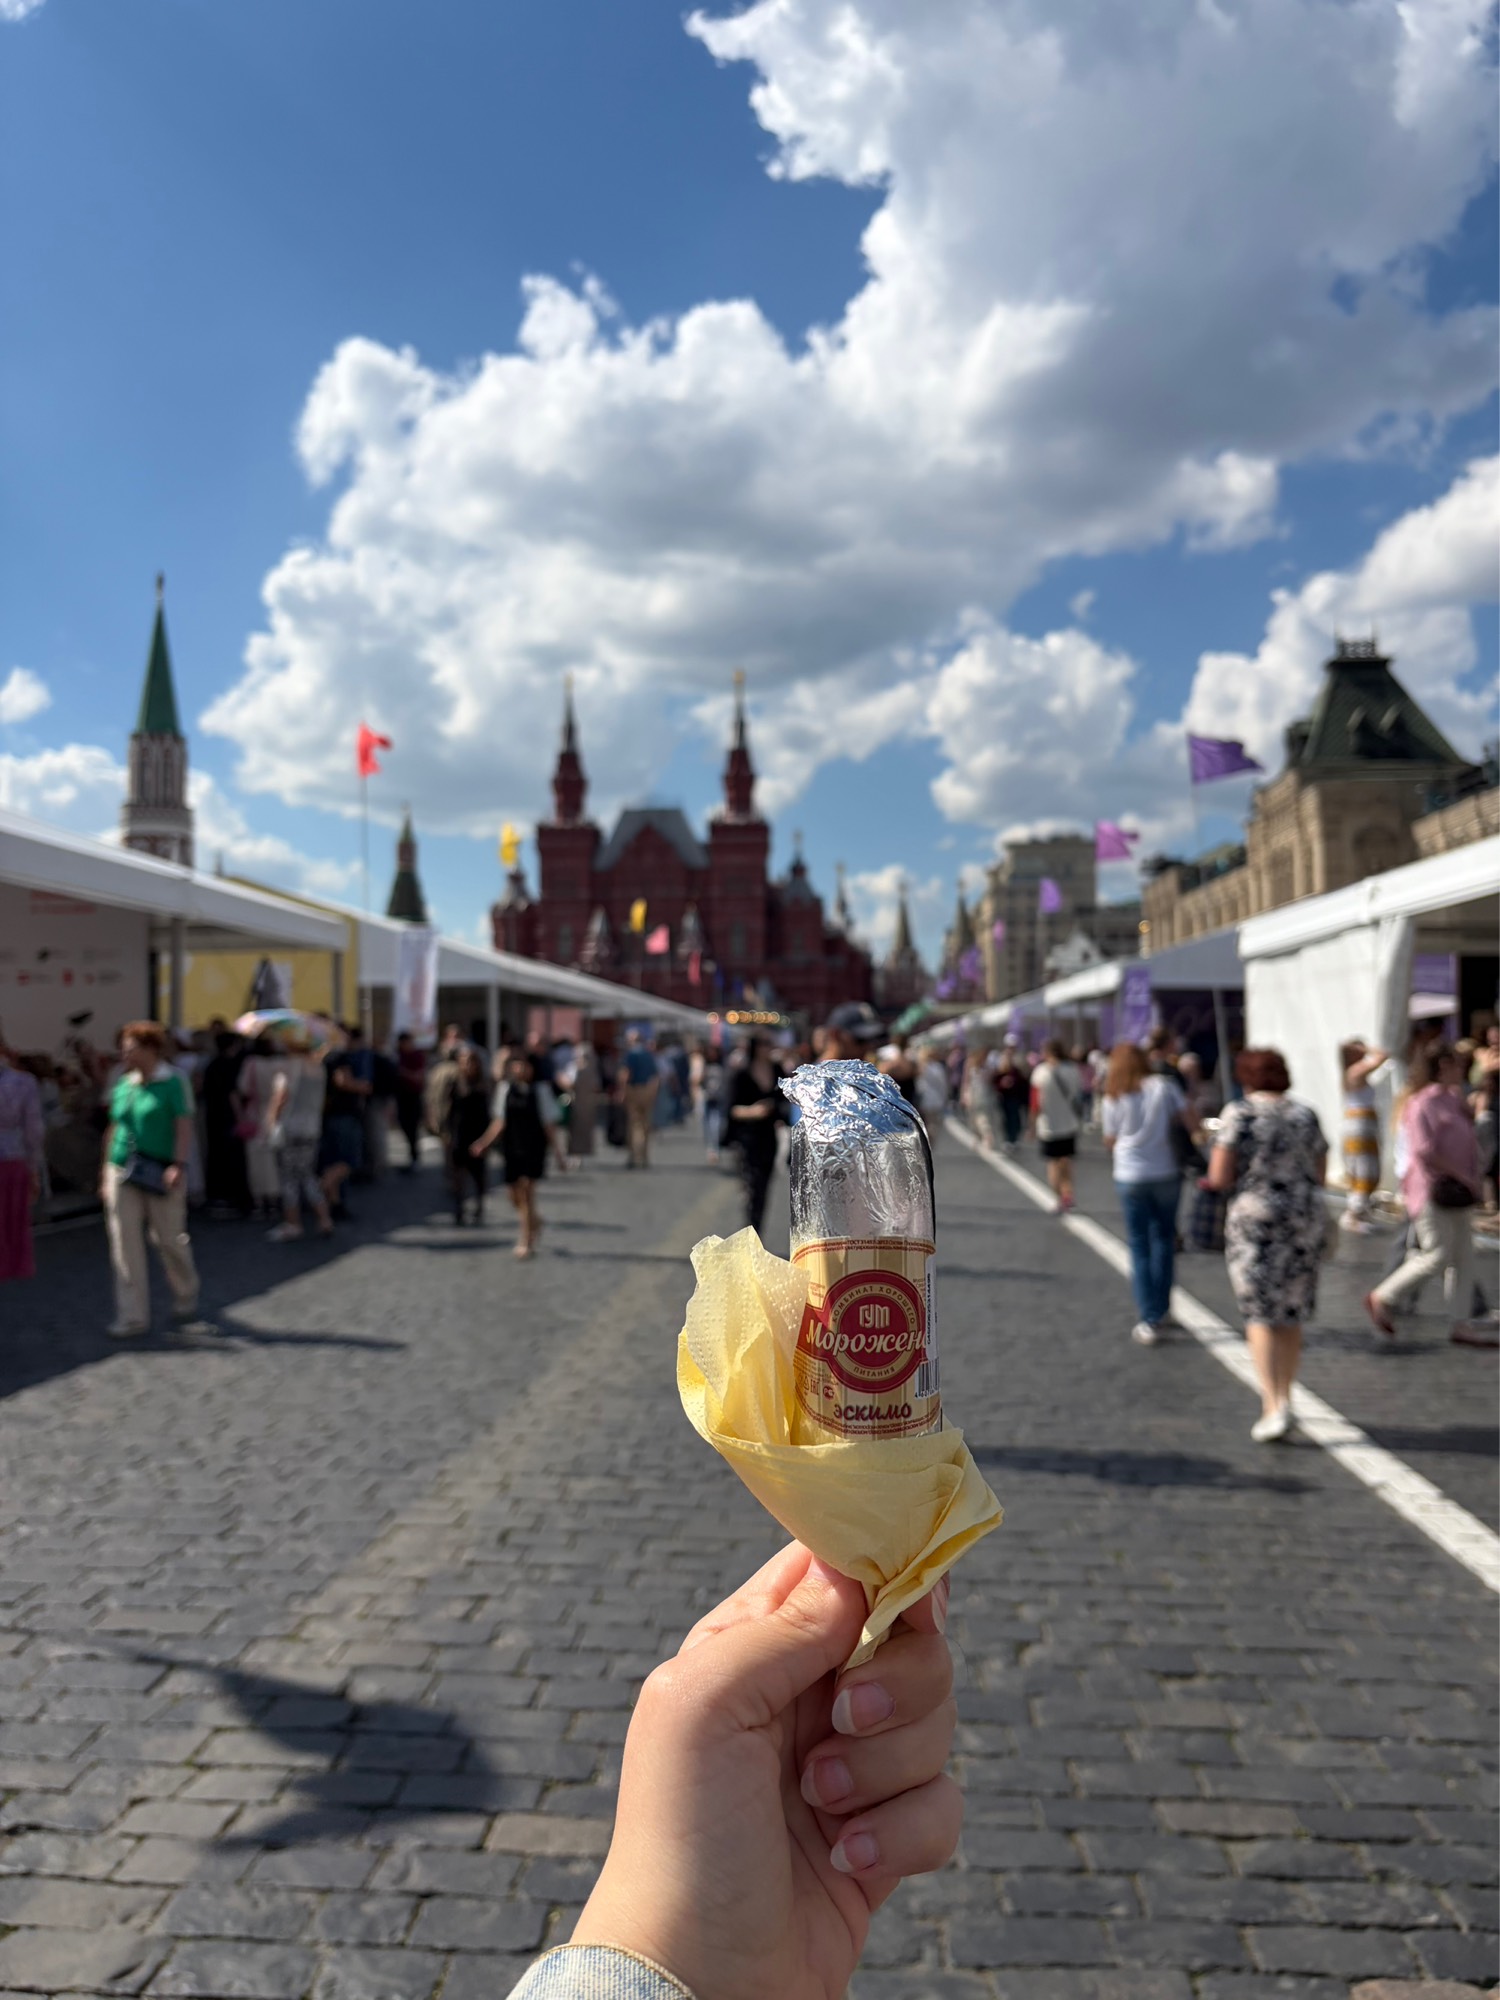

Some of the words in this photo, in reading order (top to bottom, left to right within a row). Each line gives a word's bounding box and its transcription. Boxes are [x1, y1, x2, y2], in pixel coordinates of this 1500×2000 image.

[832, 1286, 873, 1323] КОМБИНАТ
[879, 1286, 916, 1324] ХОРОШЕГО
[859, 1304, 890, 1328] ГУМ
[853, 1366, 896, 1377] ПИТАНИЯ
[834, 1401, 912, 1422] эскимо
